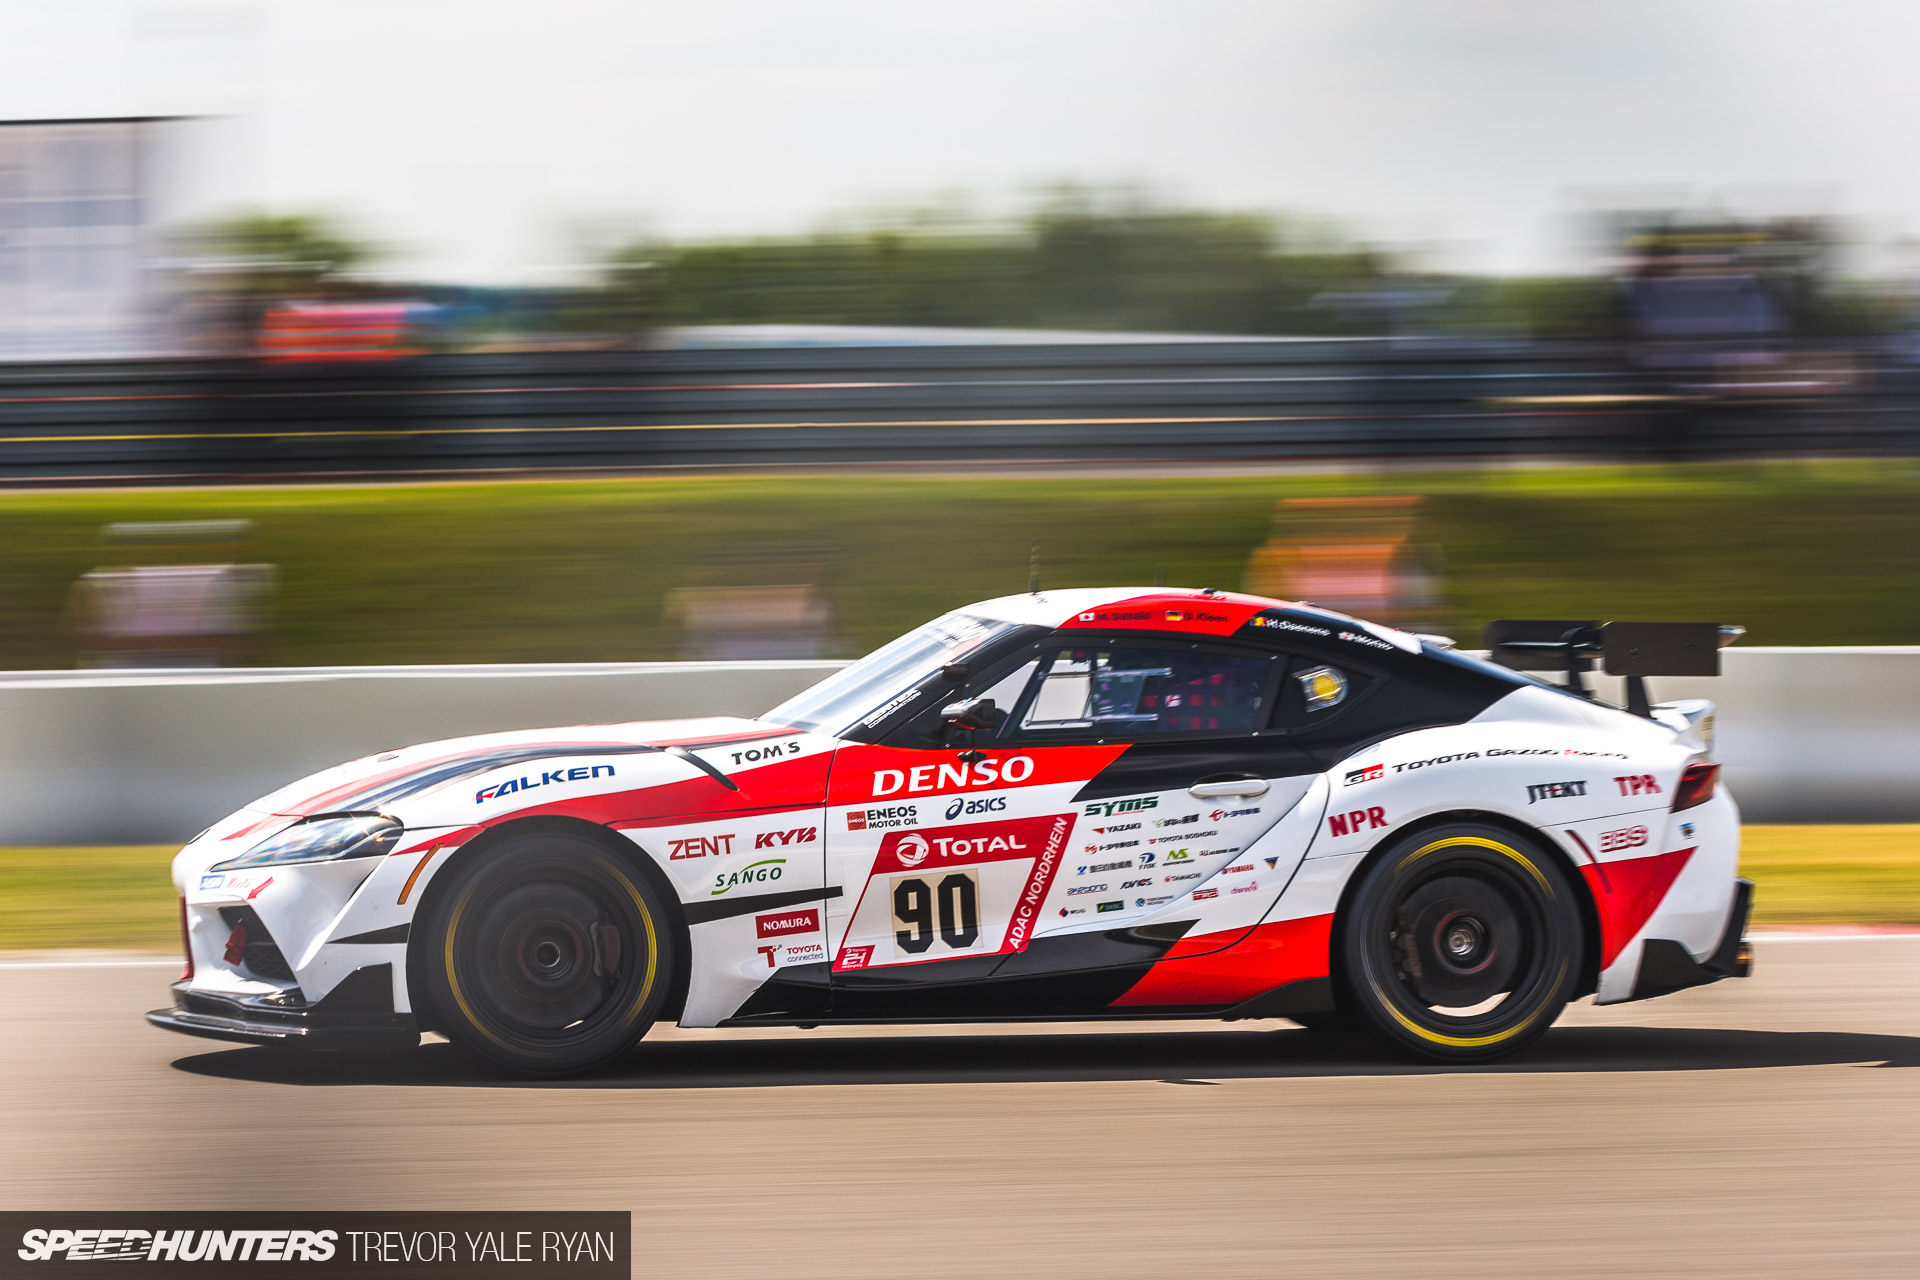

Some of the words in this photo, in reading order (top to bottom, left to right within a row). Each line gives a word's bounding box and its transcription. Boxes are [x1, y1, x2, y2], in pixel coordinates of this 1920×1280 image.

[1392, 751, 1480, 774] TOYOTA
[475, 764, 615, 804] FALKEN
[872, 756, 1034, 796] DENSO
[1344, 768, 1384, 788] GR
[1613, 774, 1663, 797] TPR
[1526, 780, 1587, 805] JTEKT
[867, 806, 917, 820] ENEOS
[965, 797, 1006, 814] asics
[868, 820, 901, 829] MOTOR
[905, 818, 918, 826] OIL
[1106, 822, 1142, 834] YAZAKI
[1327, 806, 1389, 838] NPR
[668, 834, 735, 860] ZENT
[755, 826, 816, 849] KYB
[932, 835, 1026, 857] TOTAL
[715, 867, 782, 887] SANGO
[1008, 905, 1032, 949] ADAC
[1025, 816, 1068, 906] NORDRHEIN
[763, 916, 812, 931] NOMURA
[893, 873, 978, 954] 90
[786, 944, 822, 955] TOYOTA
[787, 952, 824, 963] connected
